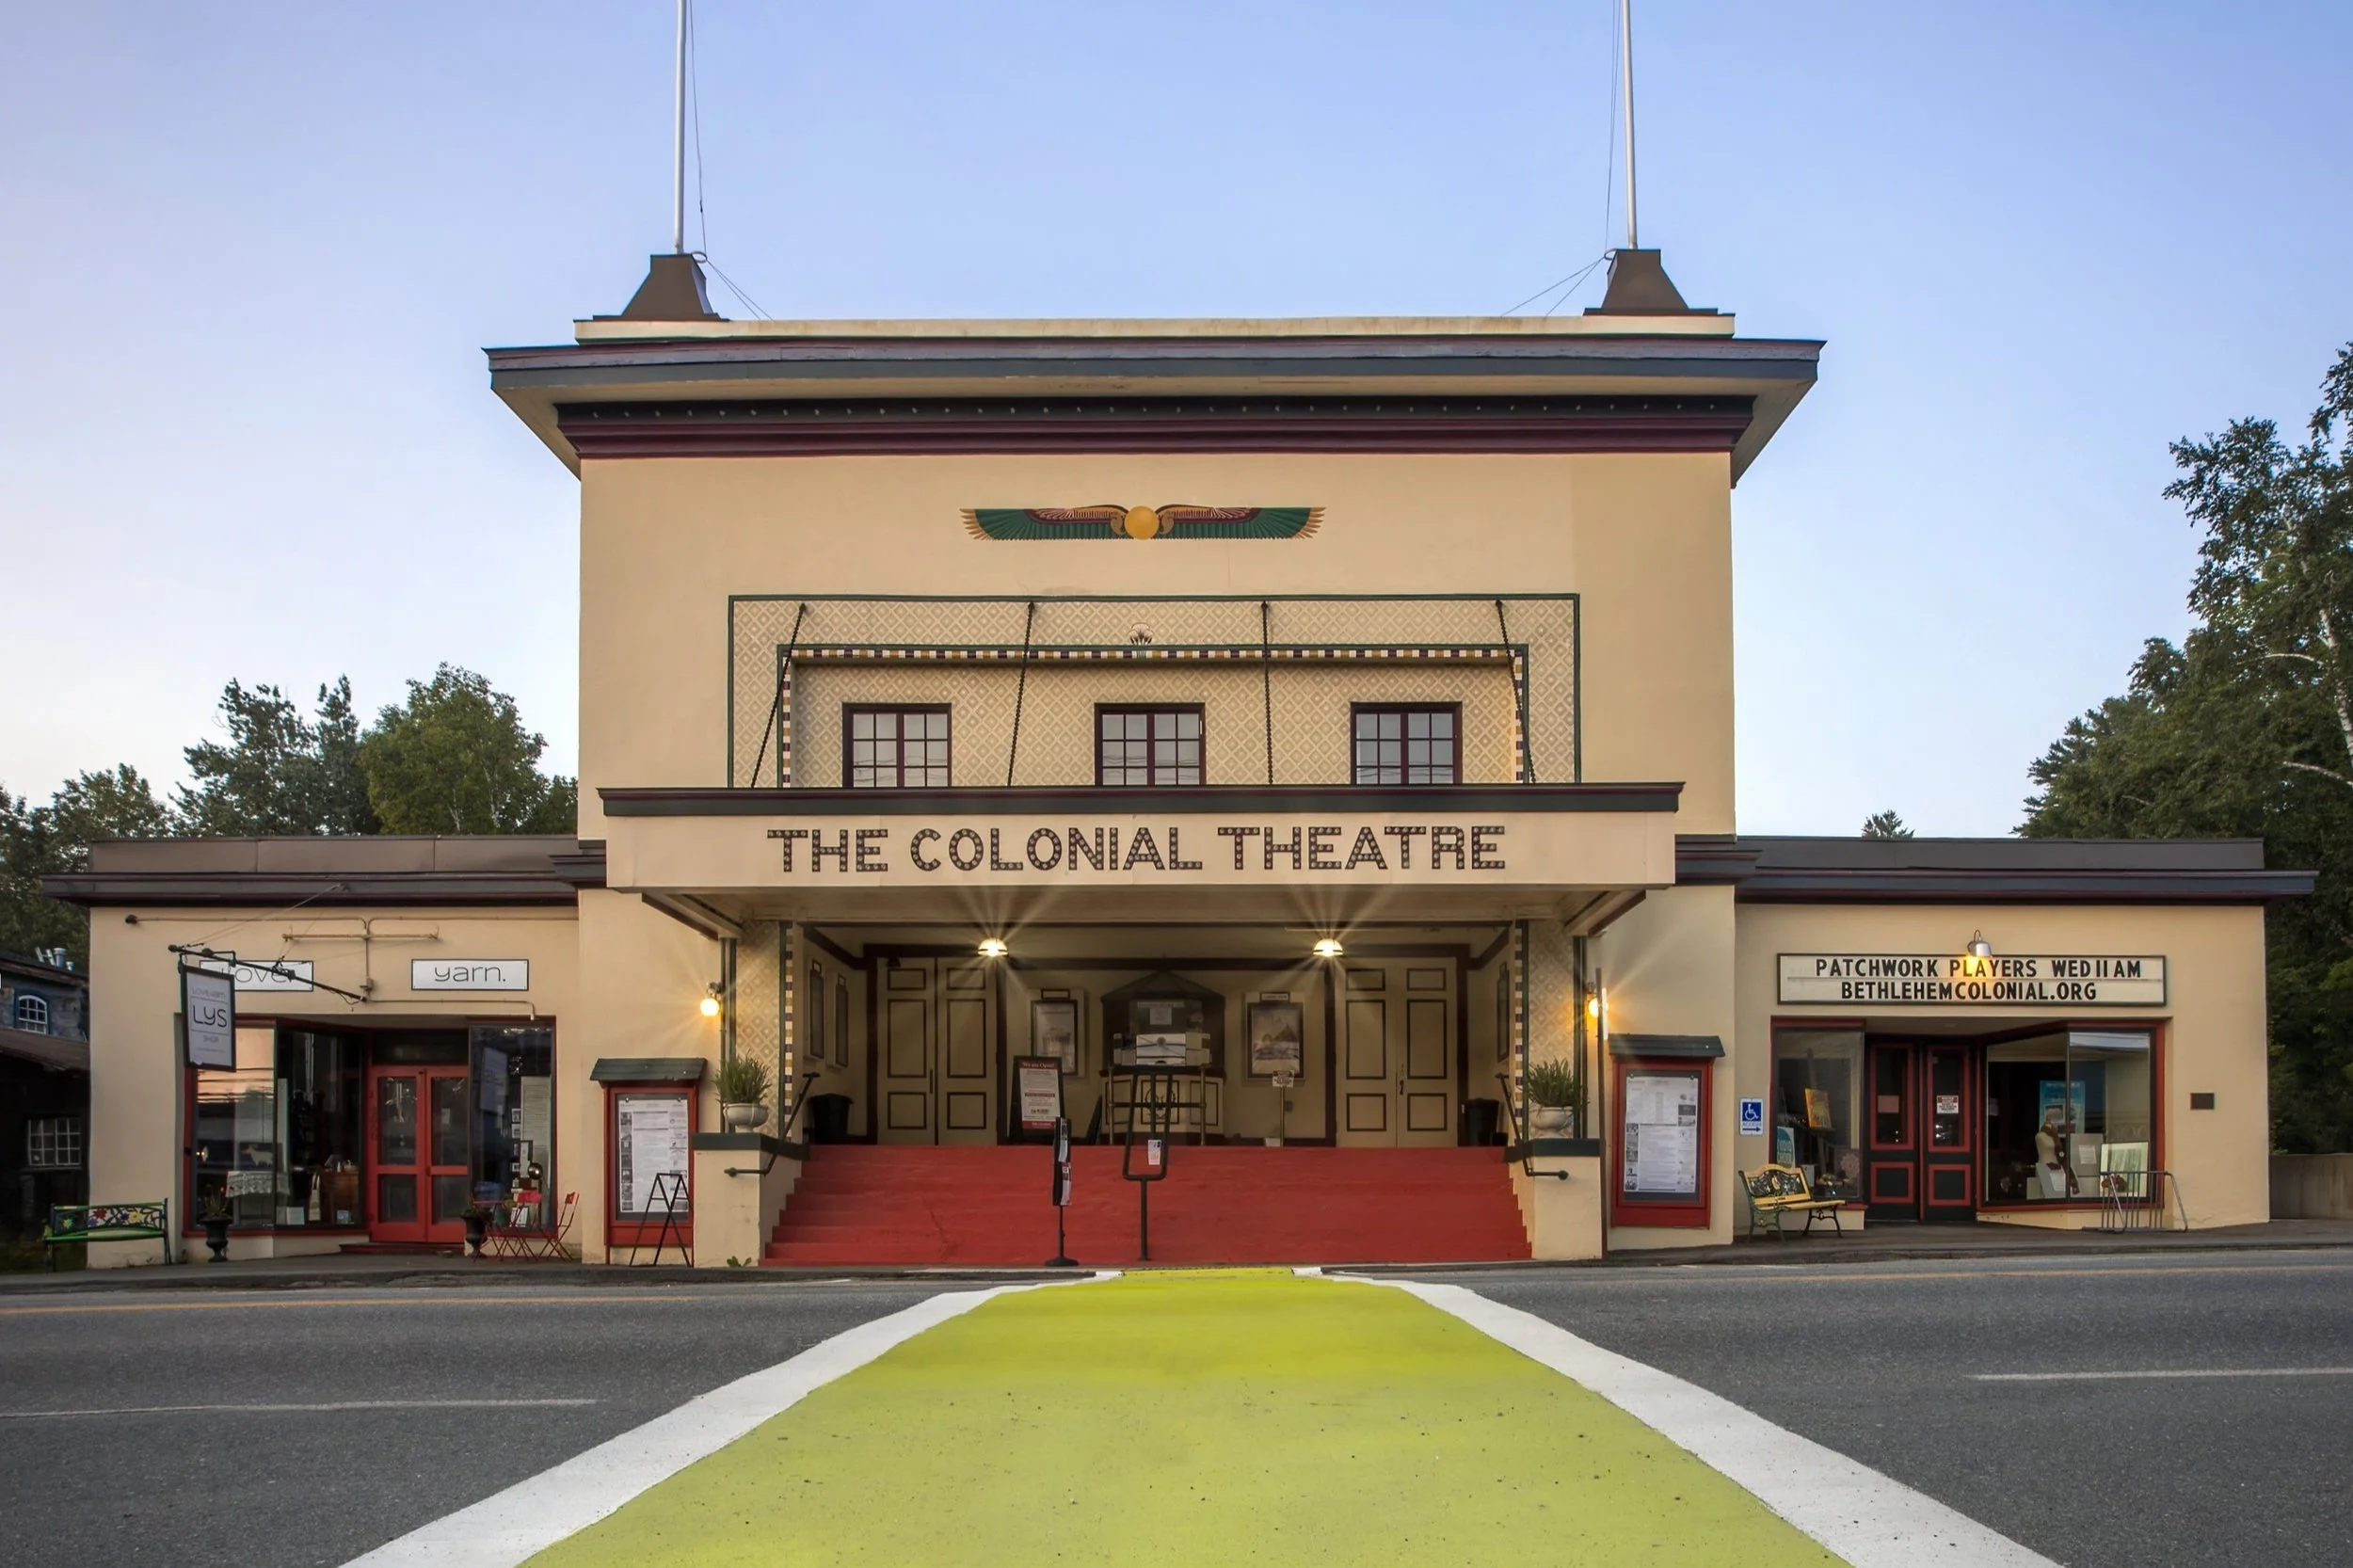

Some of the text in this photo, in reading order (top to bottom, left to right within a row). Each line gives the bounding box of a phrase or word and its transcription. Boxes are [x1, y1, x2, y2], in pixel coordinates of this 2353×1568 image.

[767, 825, 1506, 872] THE COLONIAL THEATRE
[434, 967, 506, 982] yarn.
[1816, 958, 1939, 977] PATCHWORK
[1949, 959, 2037, 978] PLAYERS
[2052, 959, 2091, 978] WED
[2113, 959, 2141, 978] AM
[1841, 982, 2097, 1000] BETHLEHEMCOLONIAL.ORG
